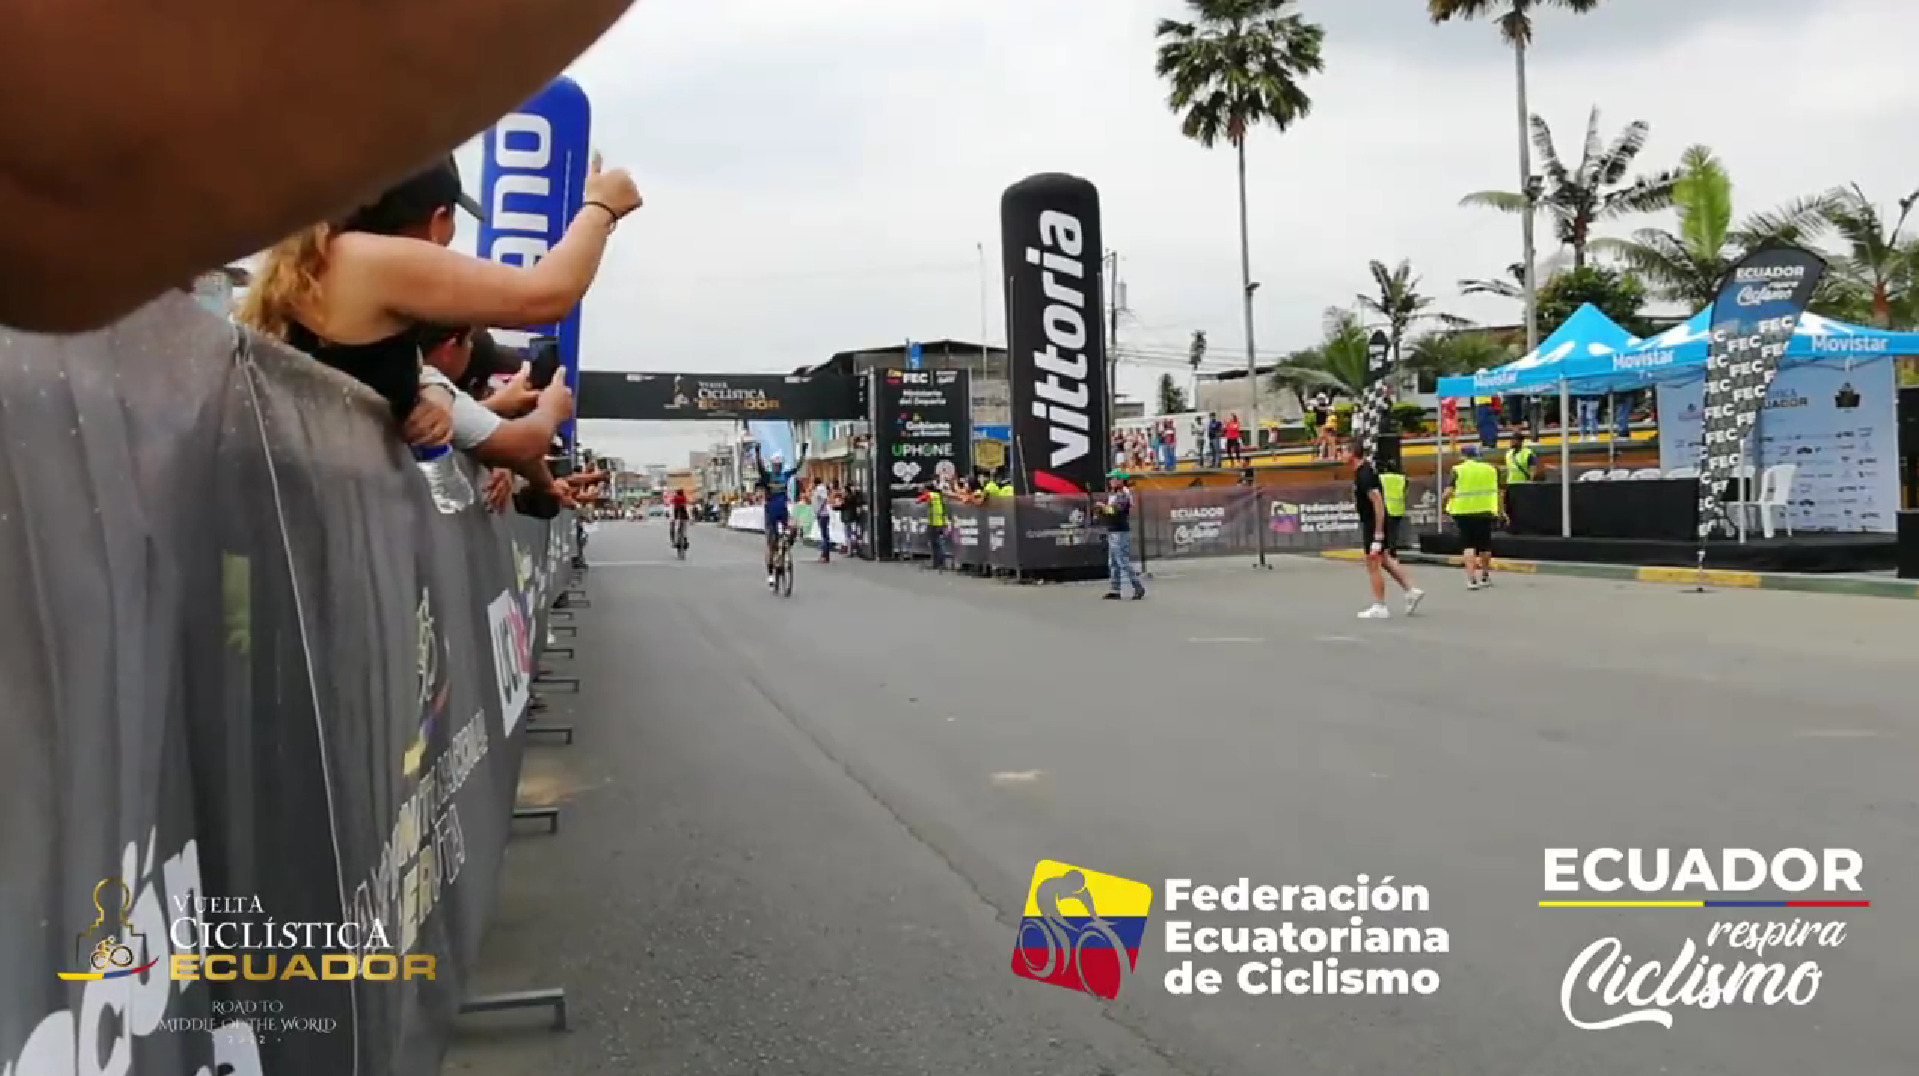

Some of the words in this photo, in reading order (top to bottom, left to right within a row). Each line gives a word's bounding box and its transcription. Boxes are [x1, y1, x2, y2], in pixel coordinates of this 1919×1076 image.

[1735, 265, 1805, 280] ECUADOR
[1759, 315, 1793, 333] FEC
[1025, 210, 1090, 468] vittoria
[1727, 335, 1762, 352] FEC
[1812, 334, 1890, 353] Movistar
[1612, 347, 1676, 371] Movistar
[1729, 360, 1764, 377] FEC
[903, 372, 928, 384] FEC
[1733, 385, 1765, 402] FEC
[1704, 404, 1735, 420] FEC
[1706, 428, 1739, 446] FEC
[892, 442, 953, 457] UPHONE
[1709, 453, 1740, 469] FEC
[1170, 506, 1225, 519] ECUADOR
